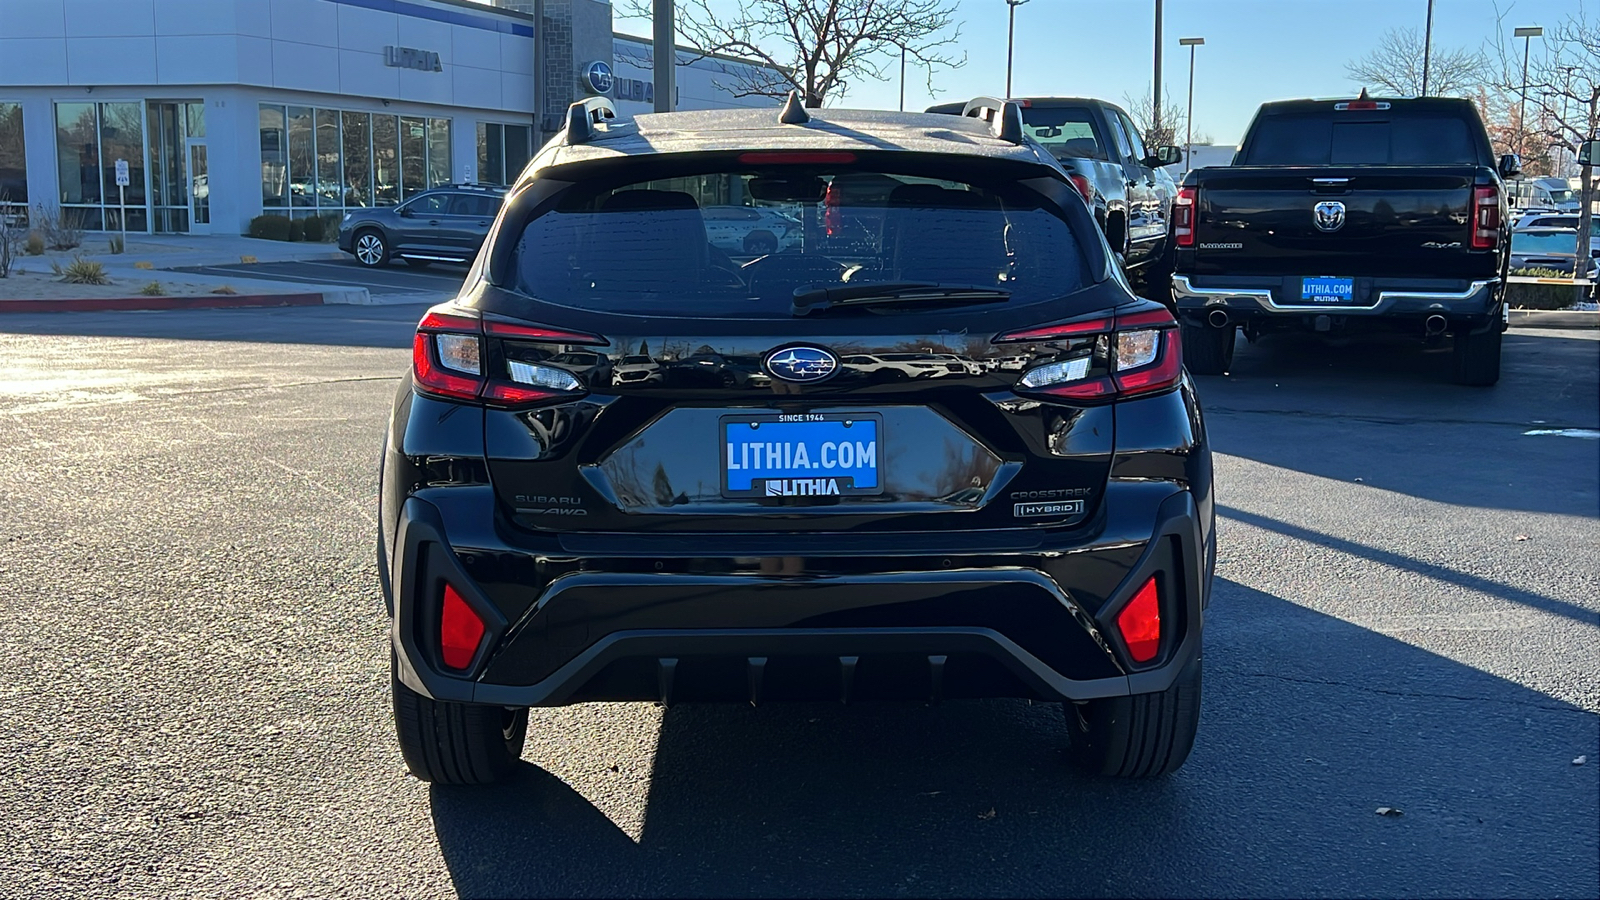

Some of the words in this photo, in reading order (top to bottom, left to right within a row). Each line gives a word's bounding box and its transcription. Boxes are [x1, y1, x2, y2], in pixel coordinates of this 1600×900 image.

[383, 45, 443, 72] LITHIA
[613, 76, 678, 106] UBA
[1302, 284, 1353, 294] LITHIA.COM
[778, 414, 803, 422] SINCE
[726, 440, 876, 470] LITHIA.COM
[782, 478, 840, 496] LITHIA
[1010, 487, 1091, 499] CROSSTREK
[515, 495, 581, 505] SUBARU
[543, 507, 588, 516] AWD
[1026, 504, 1073, 513] HYBRID
